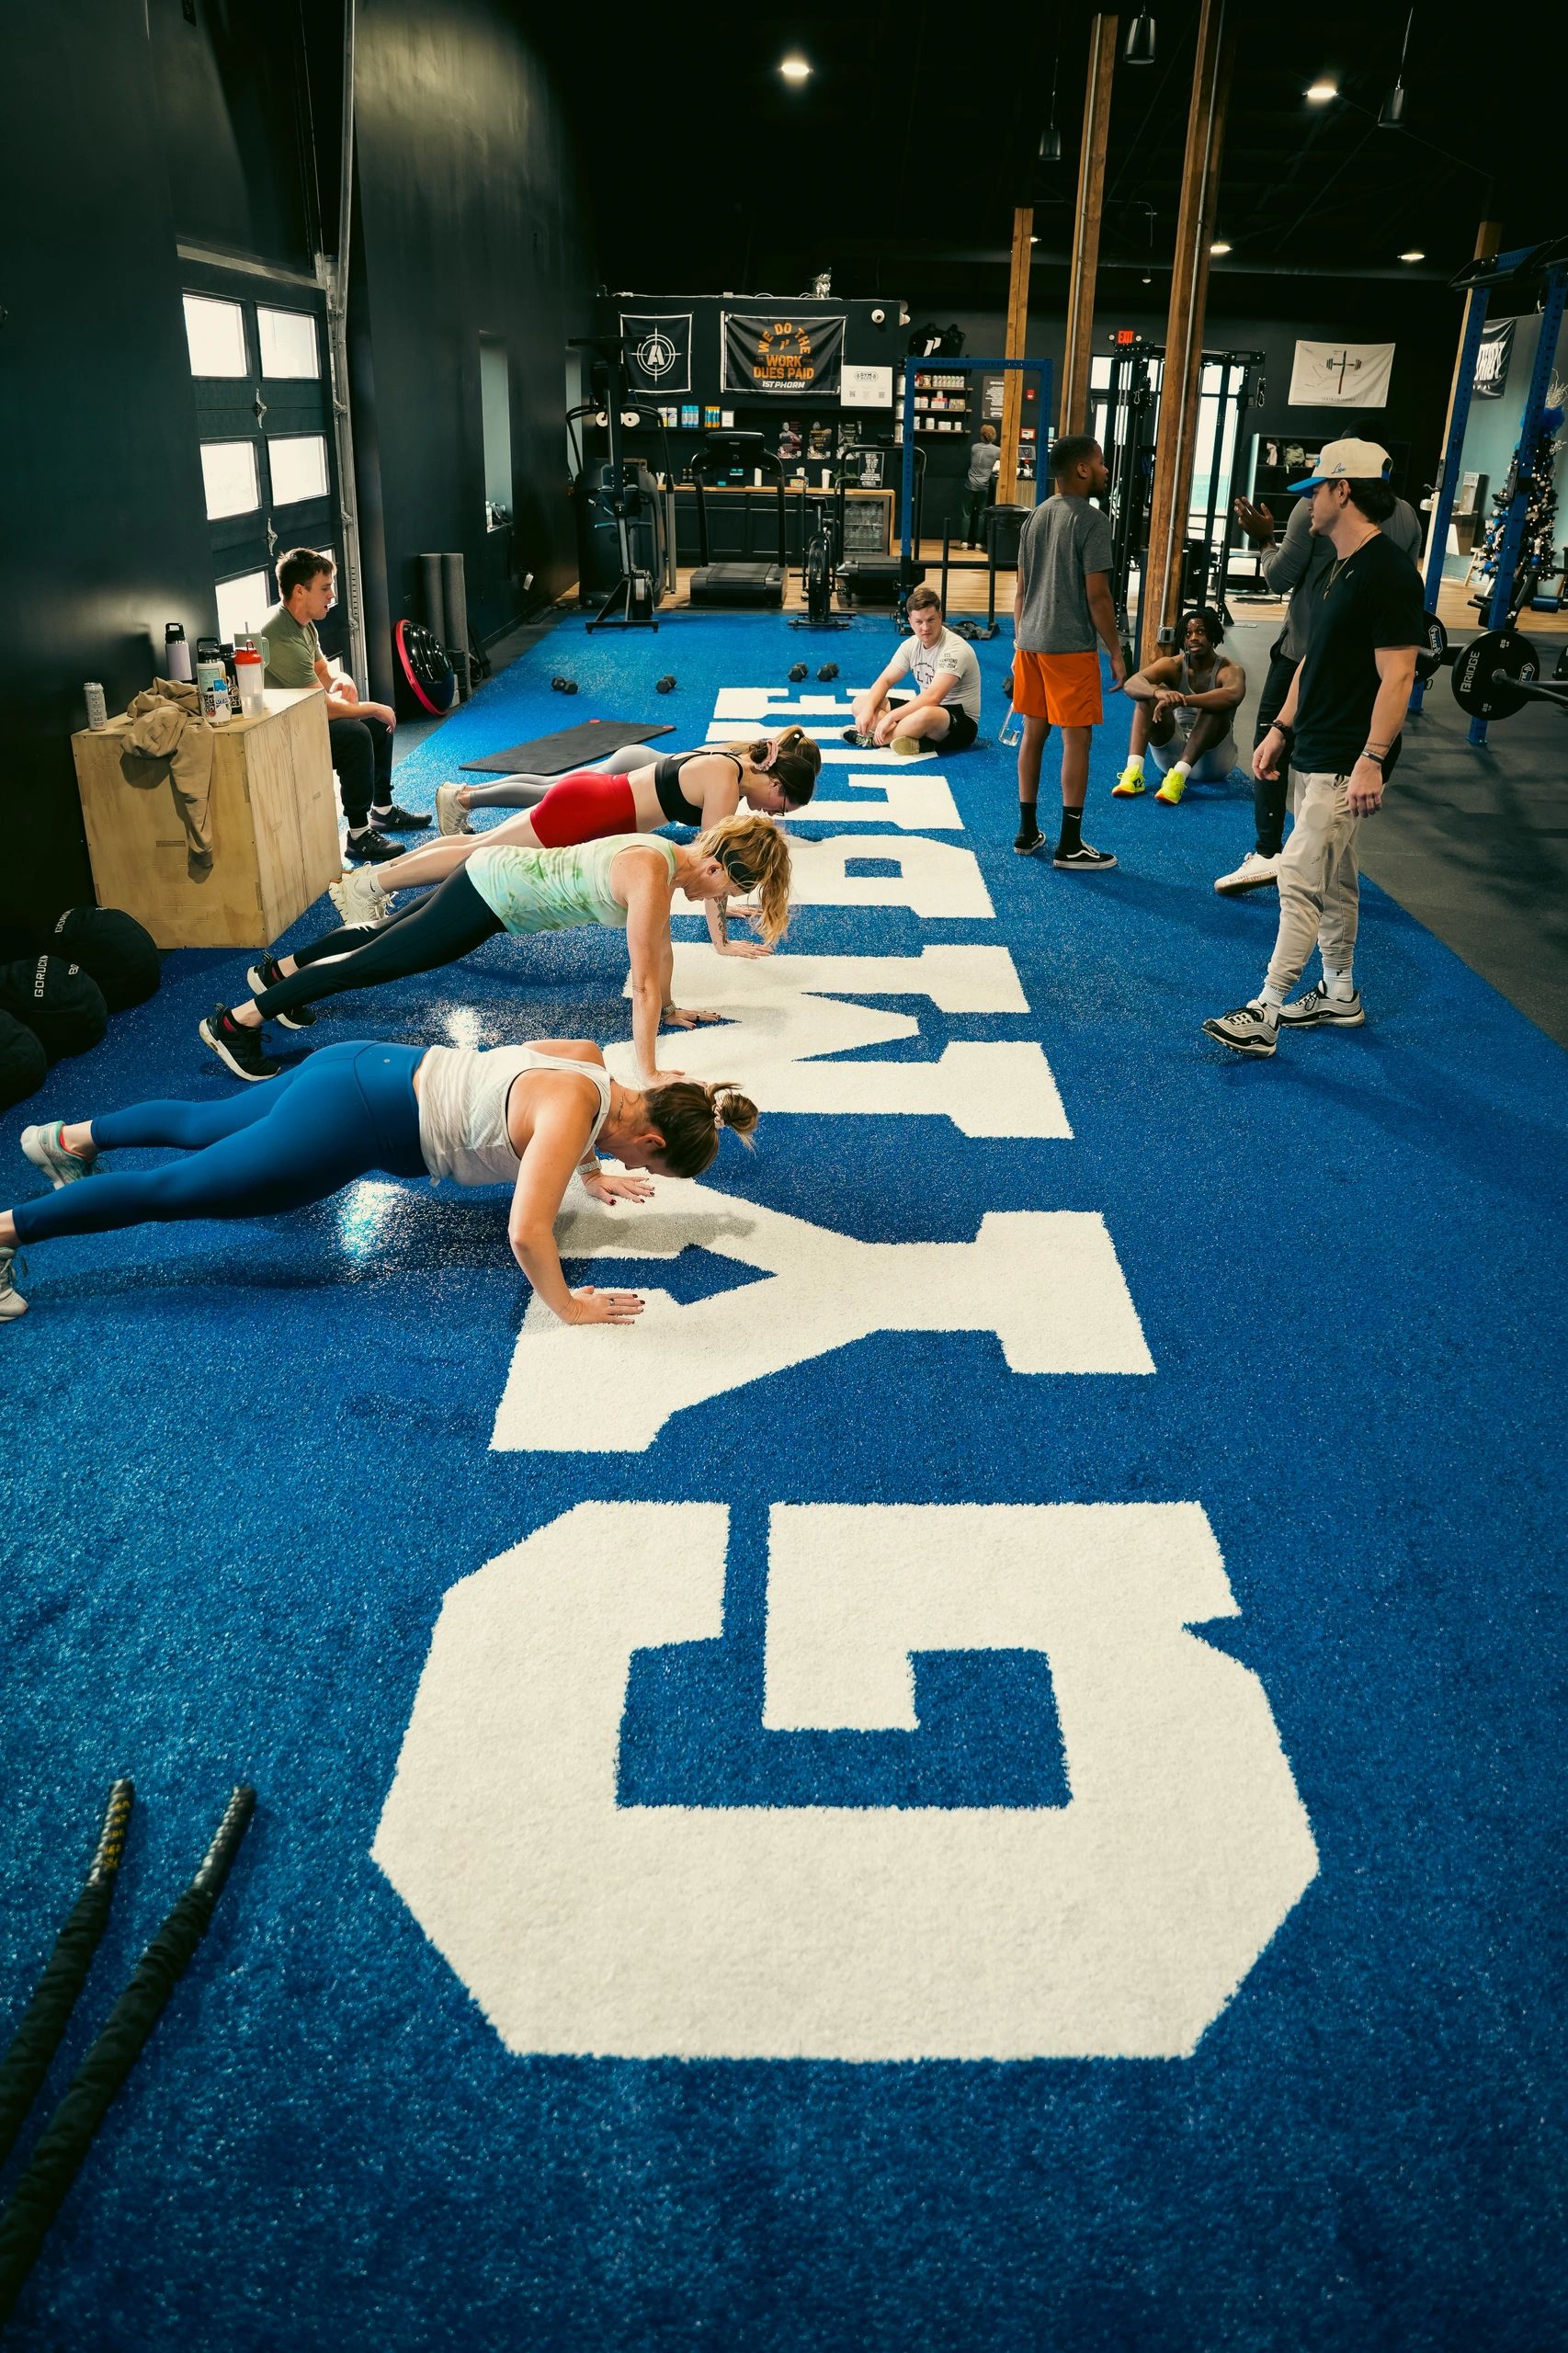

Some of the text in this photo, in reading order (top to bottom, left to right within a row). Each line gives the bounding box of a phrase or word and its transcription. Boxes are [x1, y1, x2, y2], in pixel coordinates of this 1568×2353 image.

[758, 323, 812, 354] WE DO THE
[1118, 331, 1133, 344] EXIT
[767, 355, 802, 367] WORK
[753, 367, 815, 380] DUES PAID
[1460, 650, 1481, 693] BRIDGE
